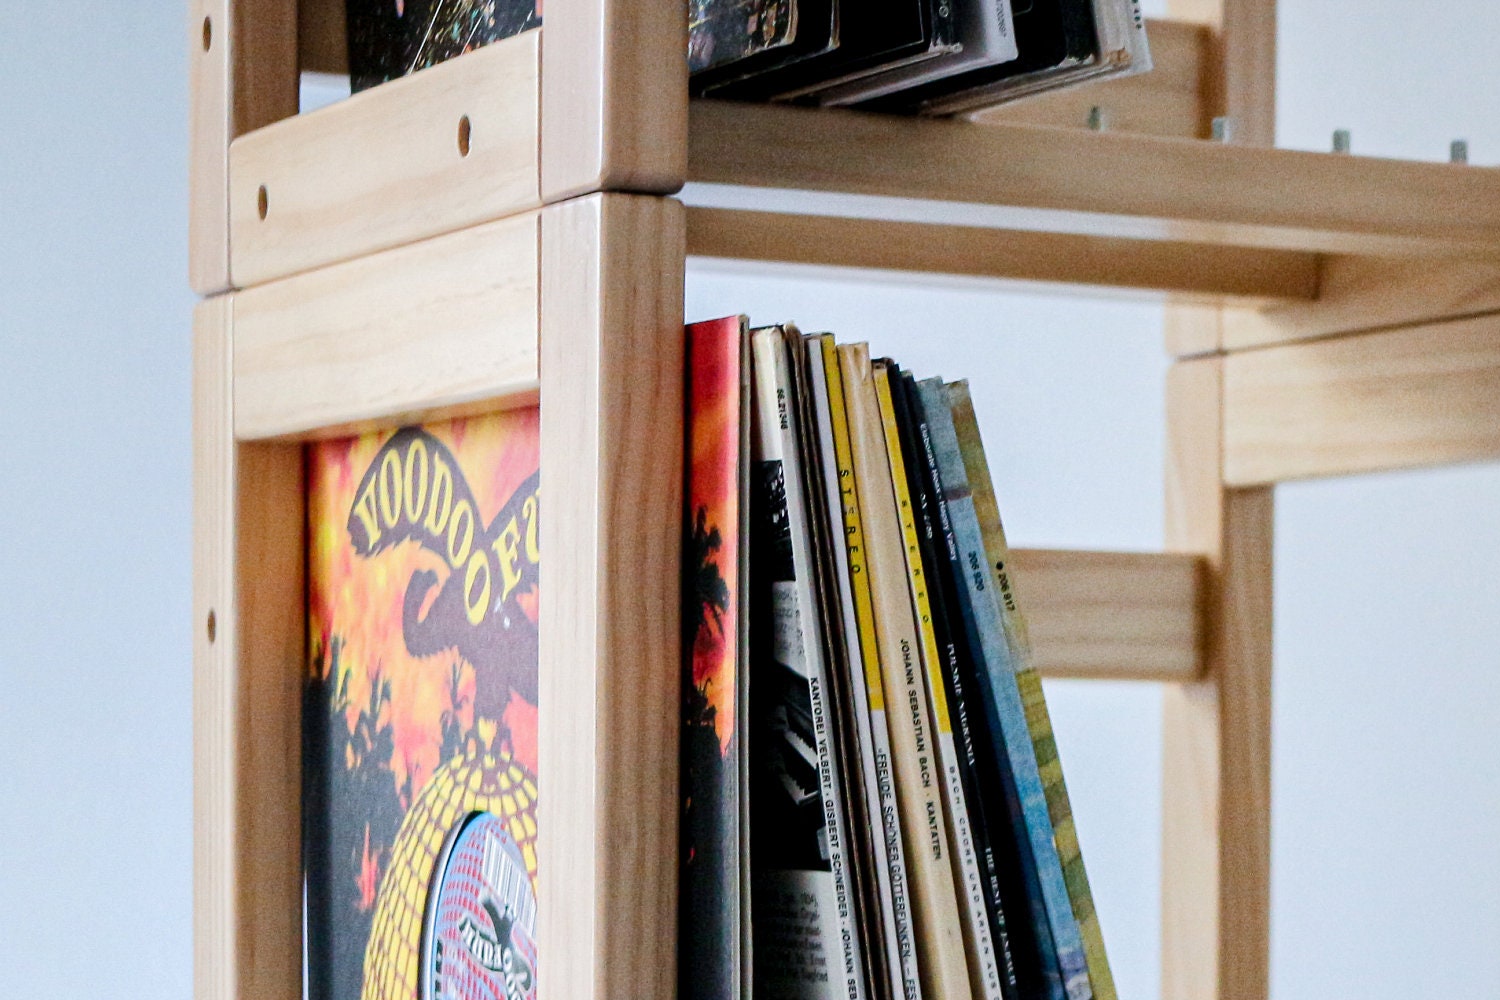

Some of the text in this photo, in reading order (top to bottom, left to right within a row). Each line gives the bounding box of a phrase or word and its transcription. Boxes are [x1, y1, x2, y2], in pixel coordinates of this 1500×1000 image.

[354, 439, 491, 625] VOODOO
[839, 469, 861, 575] STEREO
[901, 500, 930, 623] STEREO
[810, 676, 824, 734] KANTOREI
[818, 738, 831, 789] VELBERT
[826, 799, 838, 848] GISBERT
[832, 853, 847, 918] SCHNEIDER
[842, 927, 854, 973] JOHANN
[899, 637, 942, 861] JOHANN SEBASTIAN BACH KANTATEN
[969, 872, 980, 902] UND
[976, 909, 990, 954] ARIEN
[986, 961, 996, 989] AUS
